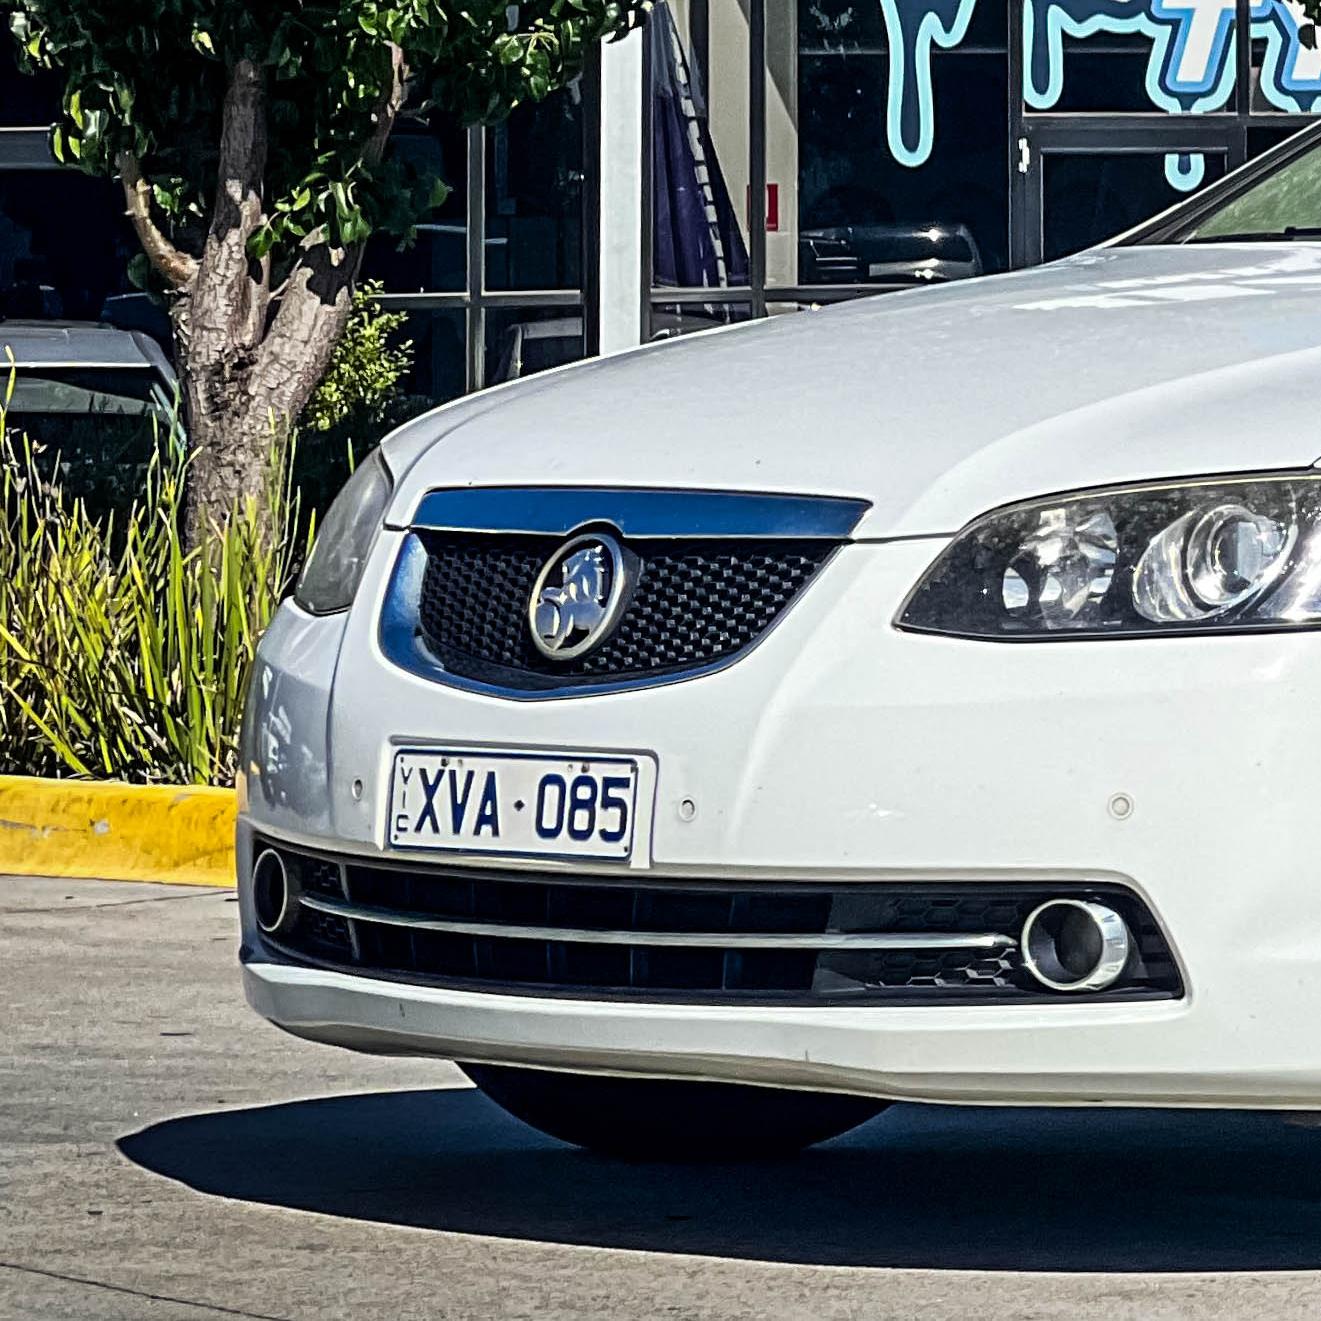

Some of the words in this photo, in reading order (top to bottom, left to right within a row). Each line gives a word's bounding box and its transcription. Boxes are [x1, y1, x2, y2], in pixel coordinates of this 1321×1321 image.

[395, 766, 413, 833] VIC
[414, 767, 500, 838] XVA
[535, 773, 631, 843] 085
